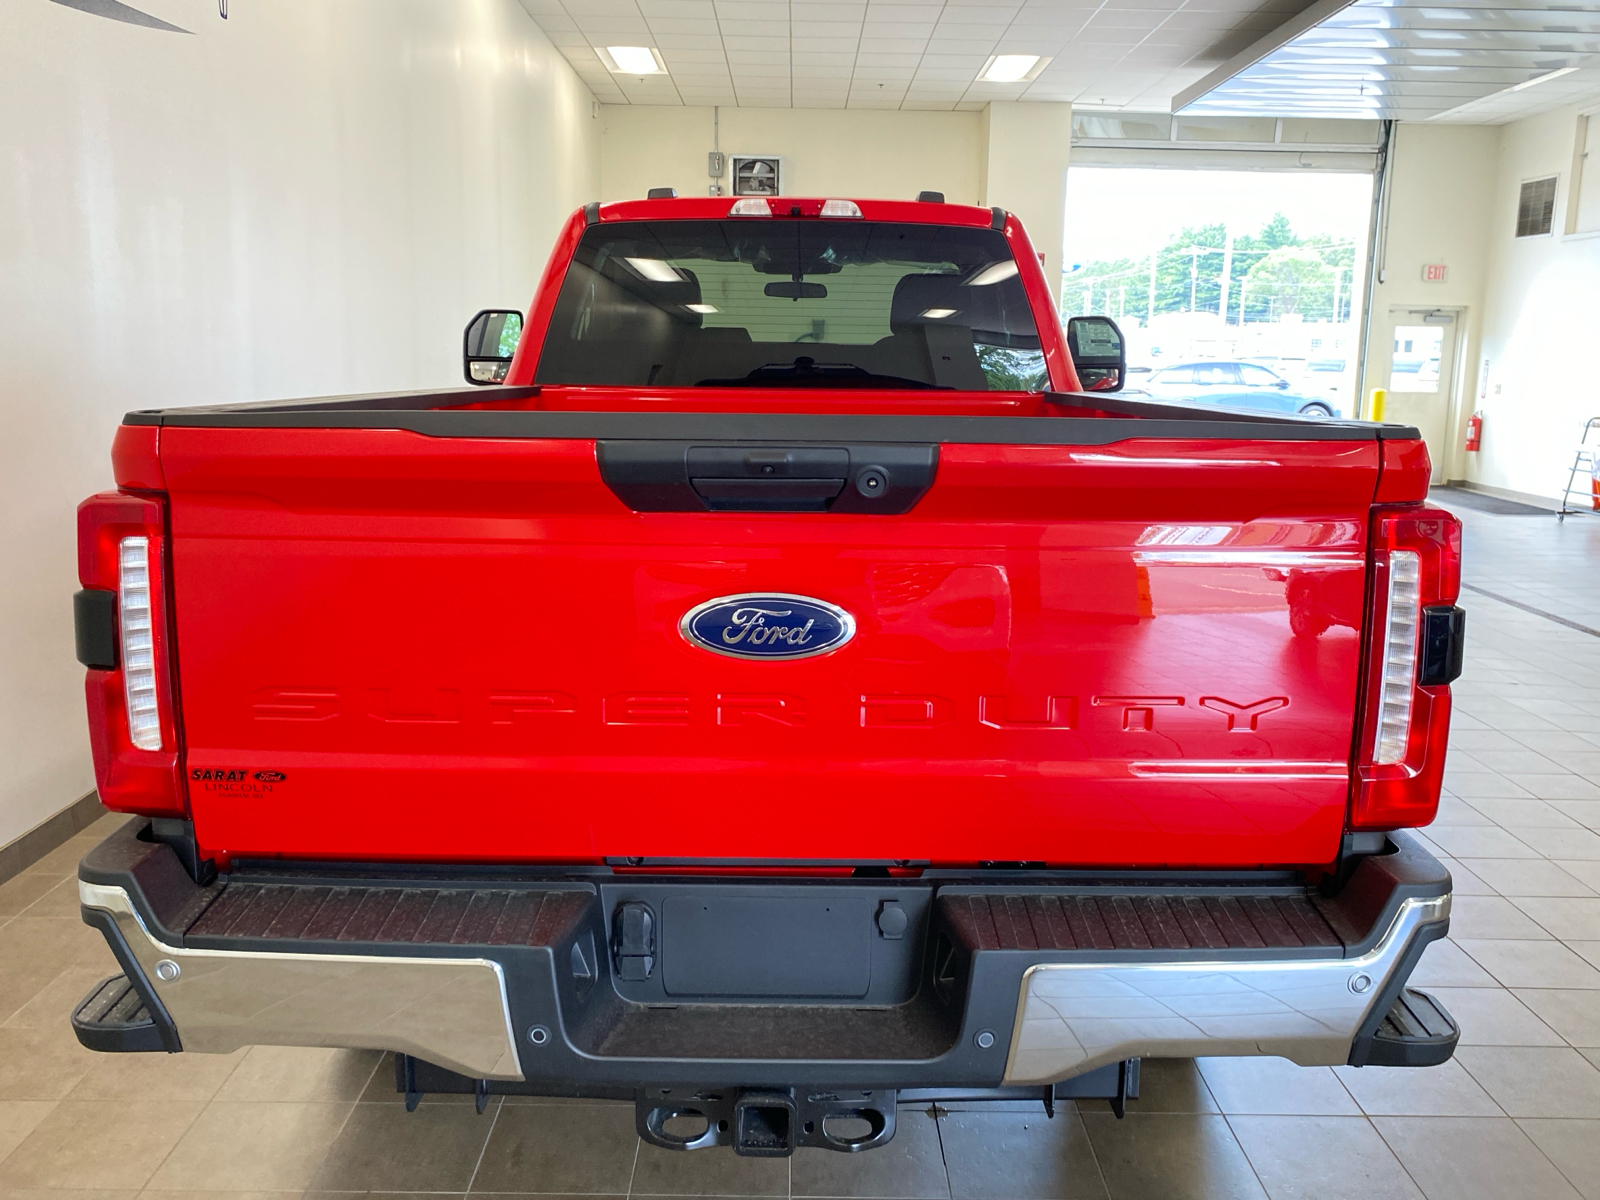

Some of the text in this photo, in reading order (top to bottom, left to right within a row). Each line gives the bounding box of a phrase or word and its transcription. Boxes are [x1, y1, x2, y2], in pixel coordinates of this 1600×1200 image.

[1427, 264, 1447, 280] EXIT
[722, 607, 815, 645] Ford
[252, 686, 1290, 733] SUPER DUTY
[192, 769, 248, 781] SARAT
[205, 783, 273, 792] LINCOLN
